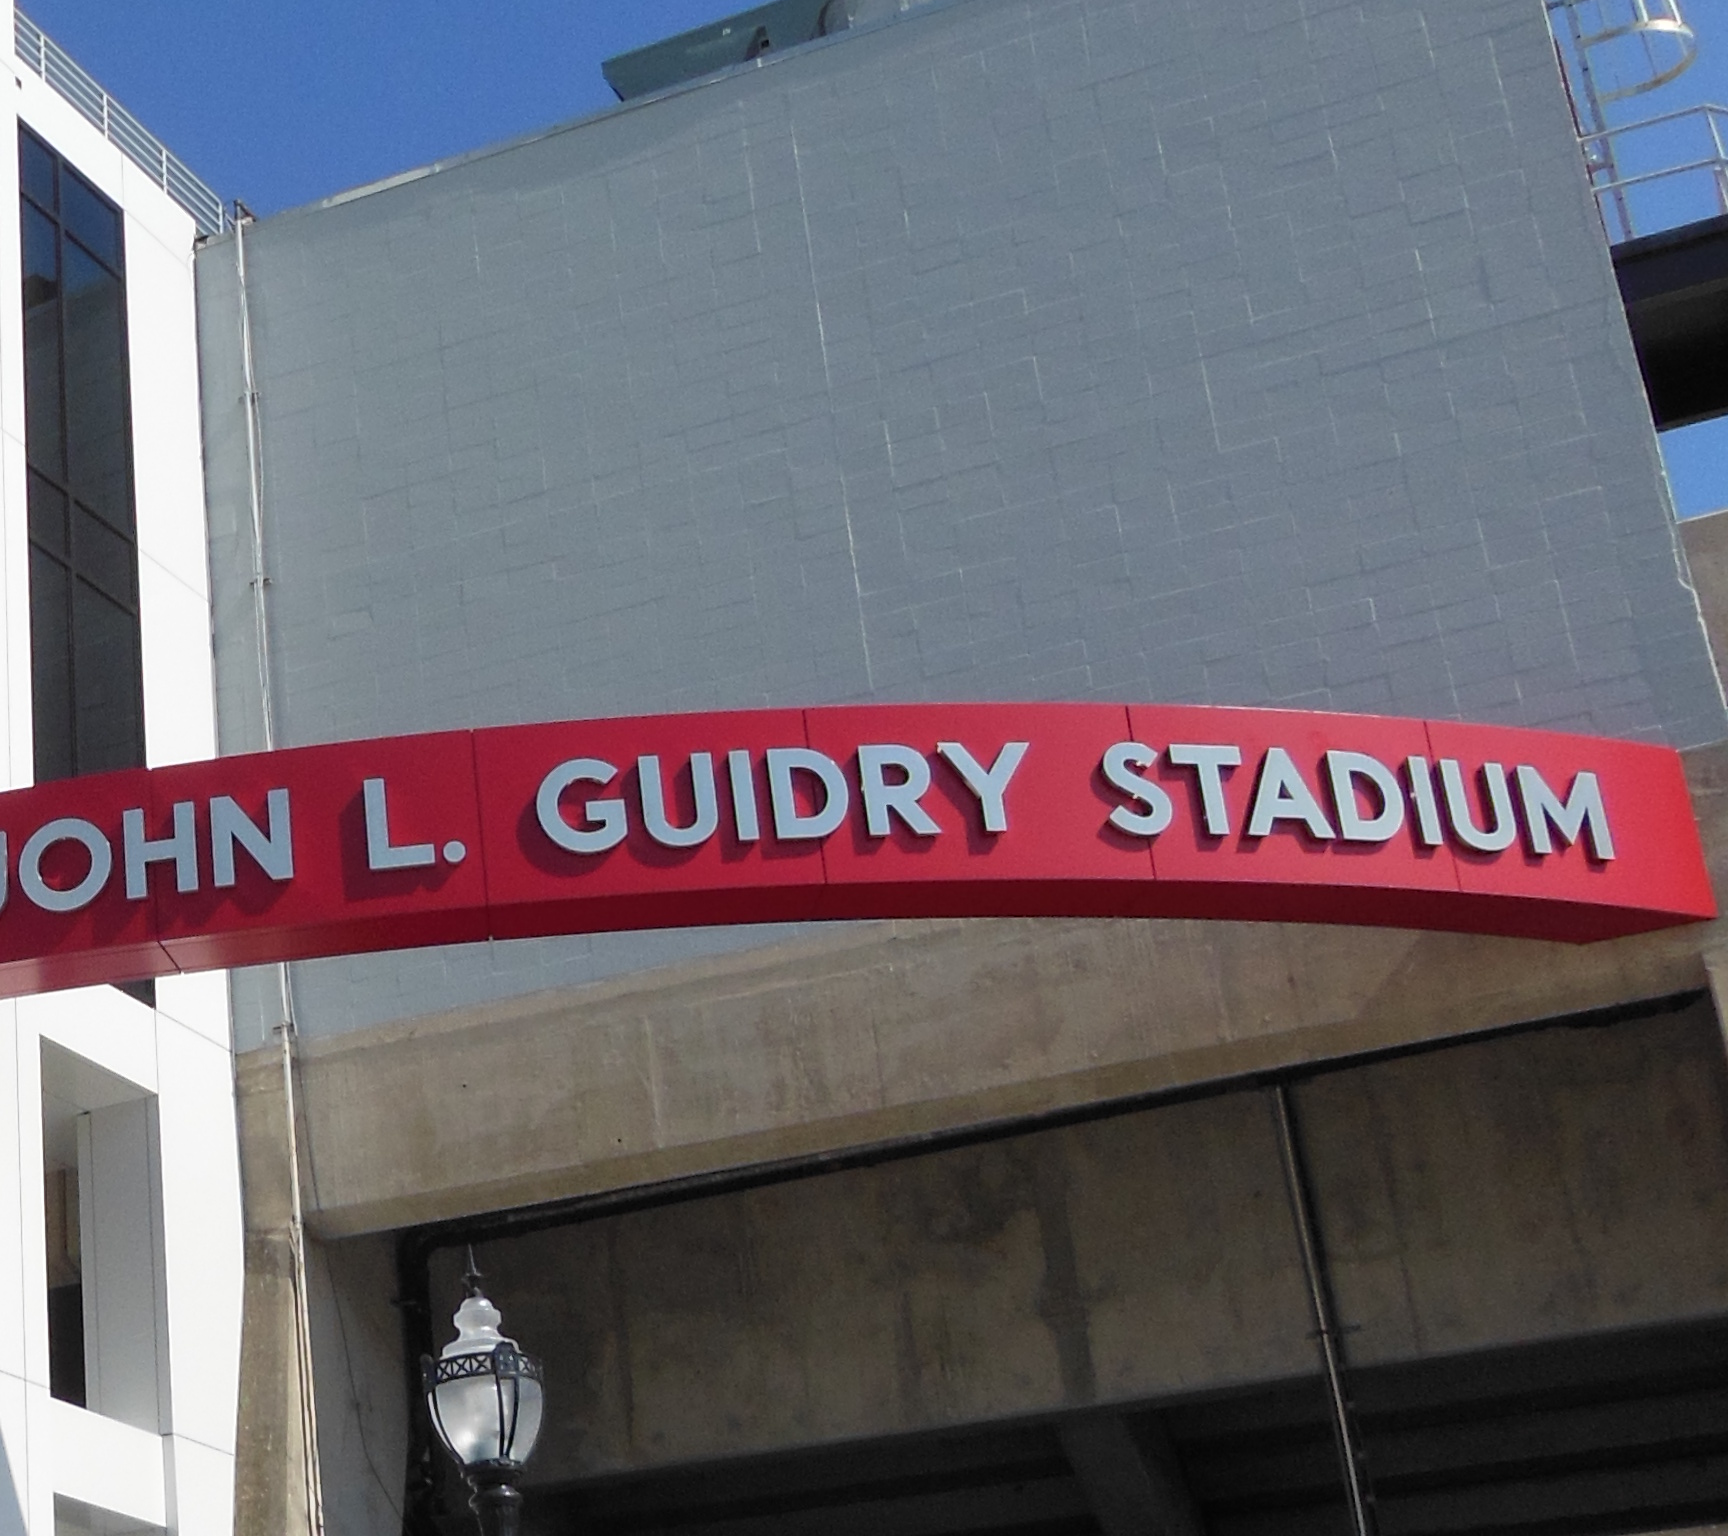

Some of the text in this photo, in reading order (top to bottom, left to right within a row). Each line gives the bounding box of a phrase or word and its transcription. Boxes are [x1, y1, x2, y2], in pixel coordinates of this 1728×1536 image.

[363, 776, 467, 871] L.
[535, 740, 1031, 856] GUIDRY
[1101, 741, 1617, 863] STADIUM
